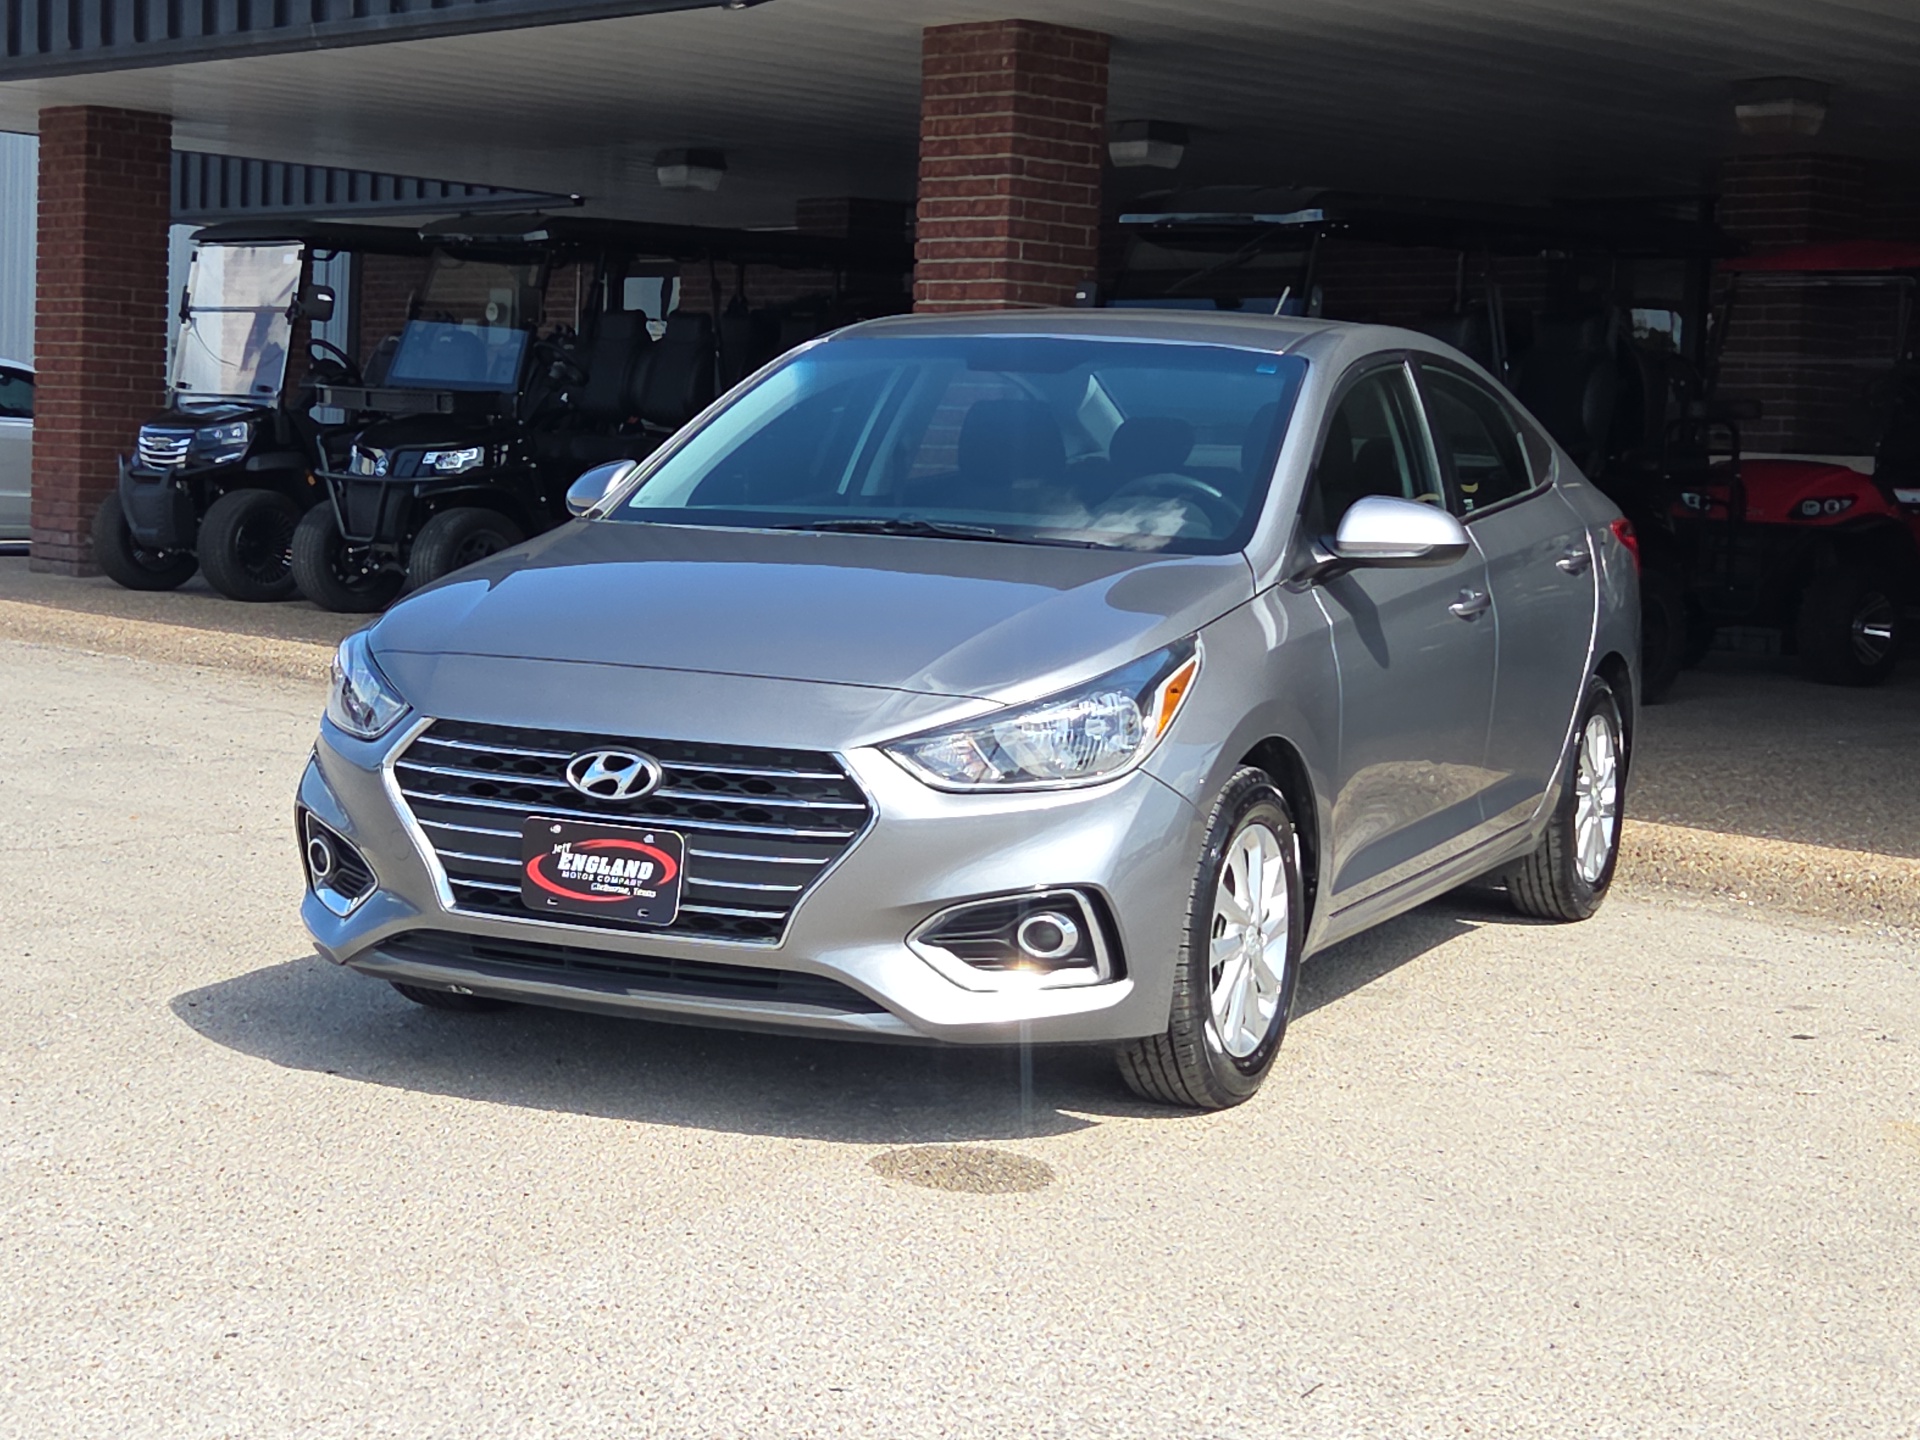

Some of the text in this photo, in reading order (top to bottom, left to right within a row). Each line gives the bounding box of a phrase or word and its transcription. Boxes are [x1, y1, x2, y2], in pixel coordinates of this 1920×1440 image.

[557, 852, 654, 880] ENGLAND
[561, 870, 643, 887] MOTOR COMPANY
